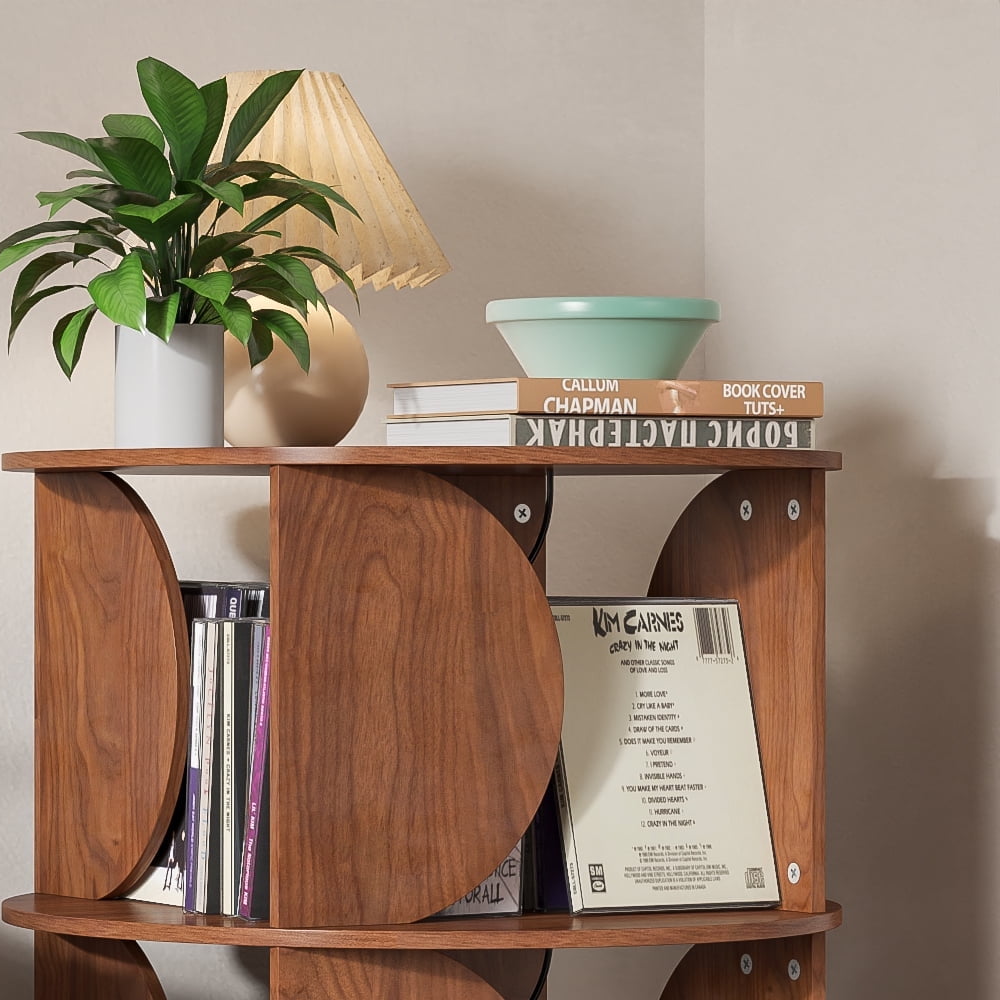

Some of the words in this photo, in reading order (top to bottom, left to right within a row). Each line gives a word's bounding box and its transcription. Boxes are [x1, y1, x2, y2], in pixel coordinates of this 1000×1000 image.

[562, 378, 619, 392] CALLUM
[723, 383, 760, 398] BOOK
[763, 384, 805, 399] COVER
[543, 397, 636, 414] CHAPMAN
[743, 401, 784, 416] TUTS+
[525, 419, 696, 447] ПАСТЕРНАК
[708, 420, 797, 447] БОРИС
[592, 607, 621, 637] KIM
[623, 609, 684, 635] CARNES
[609, 639, 632, 654] CRAZY
[635, 639, 643, 651] IN
[643, 639, 656, 652] THE
[659, 639, 679, 653] NIGHT
